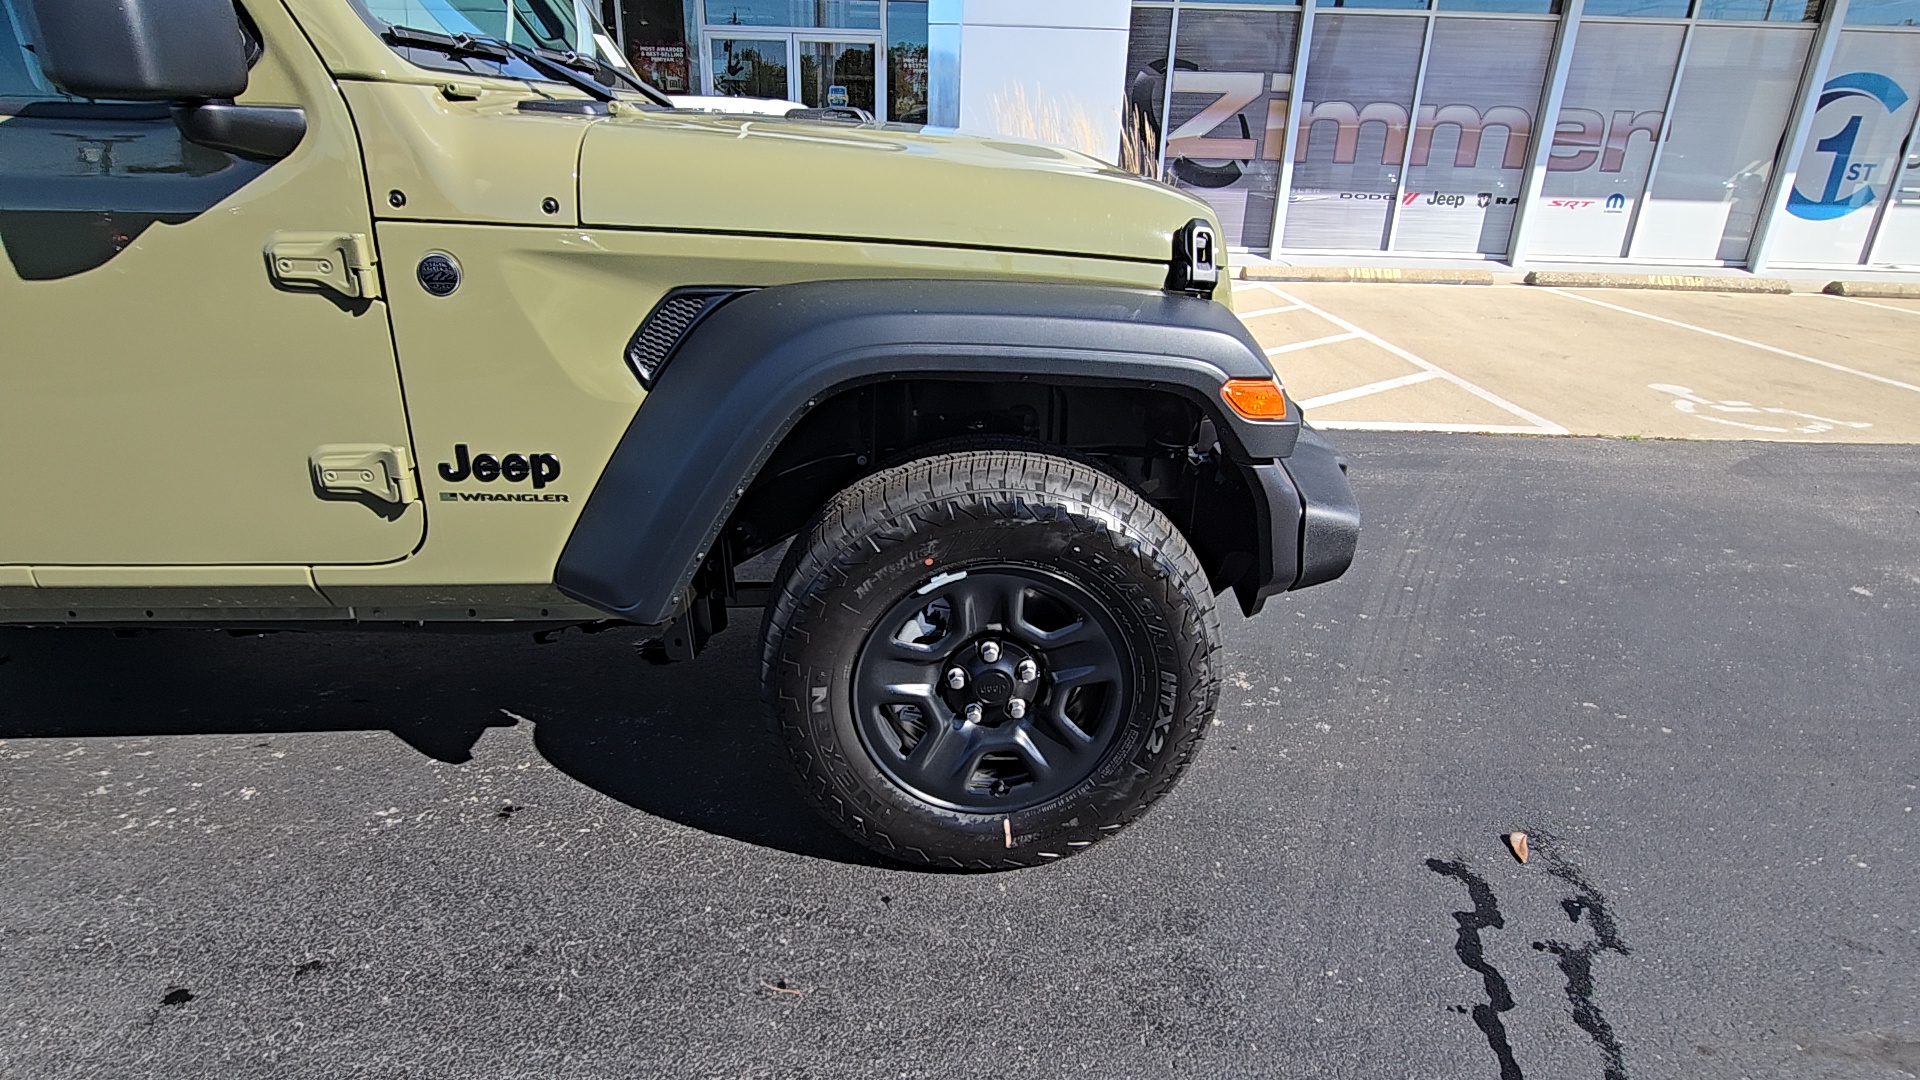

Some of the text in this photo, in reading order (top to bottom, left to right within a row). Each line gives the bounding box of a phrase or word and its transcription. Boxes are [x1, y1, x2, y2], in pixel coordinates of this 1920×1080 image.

[1339, 192, 1397, 201] DODG
[1426, 190, 1466, 208] Jeep
[1494, 196, 1519, 205] RA
[1547, 200, 1595, 210] SRT
[1347, 267, 1402, 280] VISITOR
[1647, 274, 1705, 287] VISITOR
[437, 443, 561, 490] Jeep
[458, 492, 570, 503] WRANGLER
[1144, 670, 1178, 755] HTX2
[810, 685, 884, 816] NEXEN
